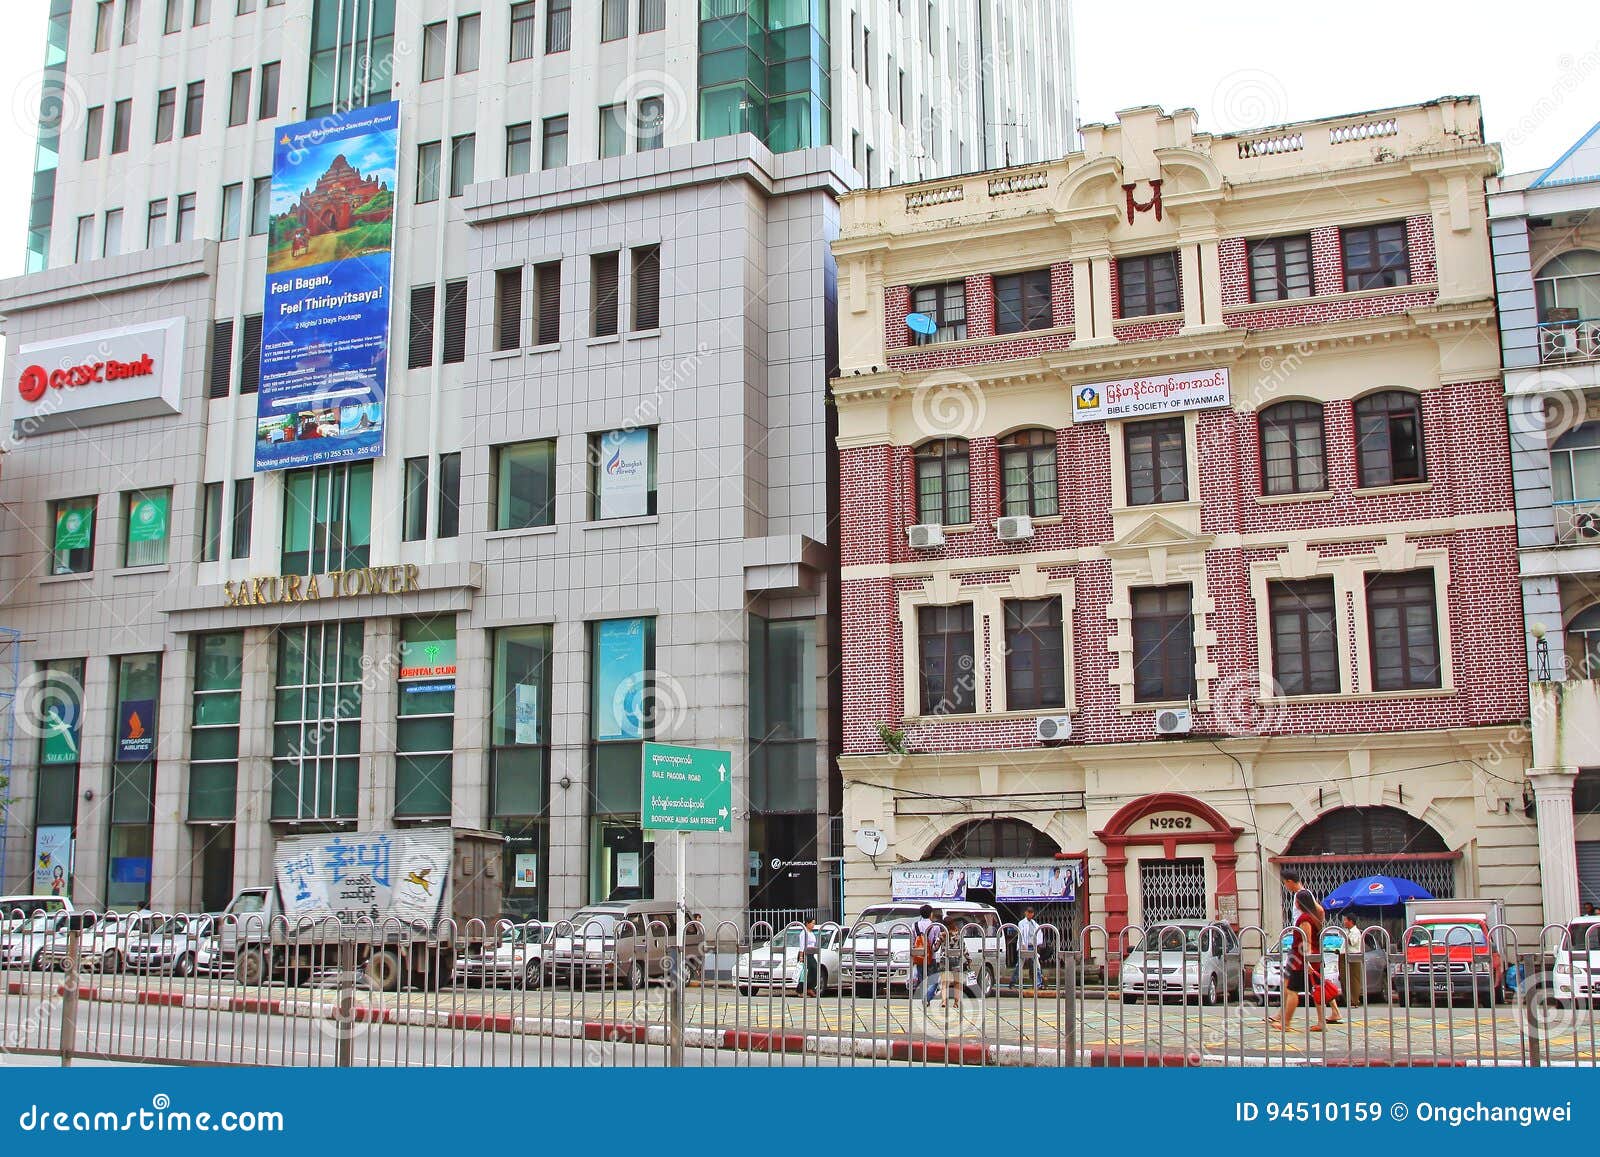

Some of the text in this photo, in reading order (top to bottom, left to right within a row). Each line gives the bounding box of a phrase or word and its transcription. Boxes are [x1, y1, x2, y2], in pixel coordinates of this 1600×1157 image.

[271, 275, 333, 295] Feel Bagan,
[281, 287, 383, 315] Feel Thiripyitsaya!
[323, 317, 337, 325] Days
[338, 313, 361, 322] Package
[106, 353, 154, 382] Bank
[1108, 406, 1130, 415] BIBLE
[1133, 402, 1167, 412] SOCIETY
[1170, 399, 1181, 408] OF
[1183, 395, 1225, 407] MYANMAR
[256, 458, 278, 468] Booking
[279, 456, 290, 465] and
[290, 454, 309, 464] Inquiry
[330, 450, 341, 458] 255
[357, 446, 369, 454] 255
[224, 563, 420, 607] SAKURA TOWER
[400, 667, 433, 677] DENTAL
[652, 770, 701, 782] SULE PAGODA ROAD
[651, 815, 717, 825] BOGYOKE AUNG SAN STREET
